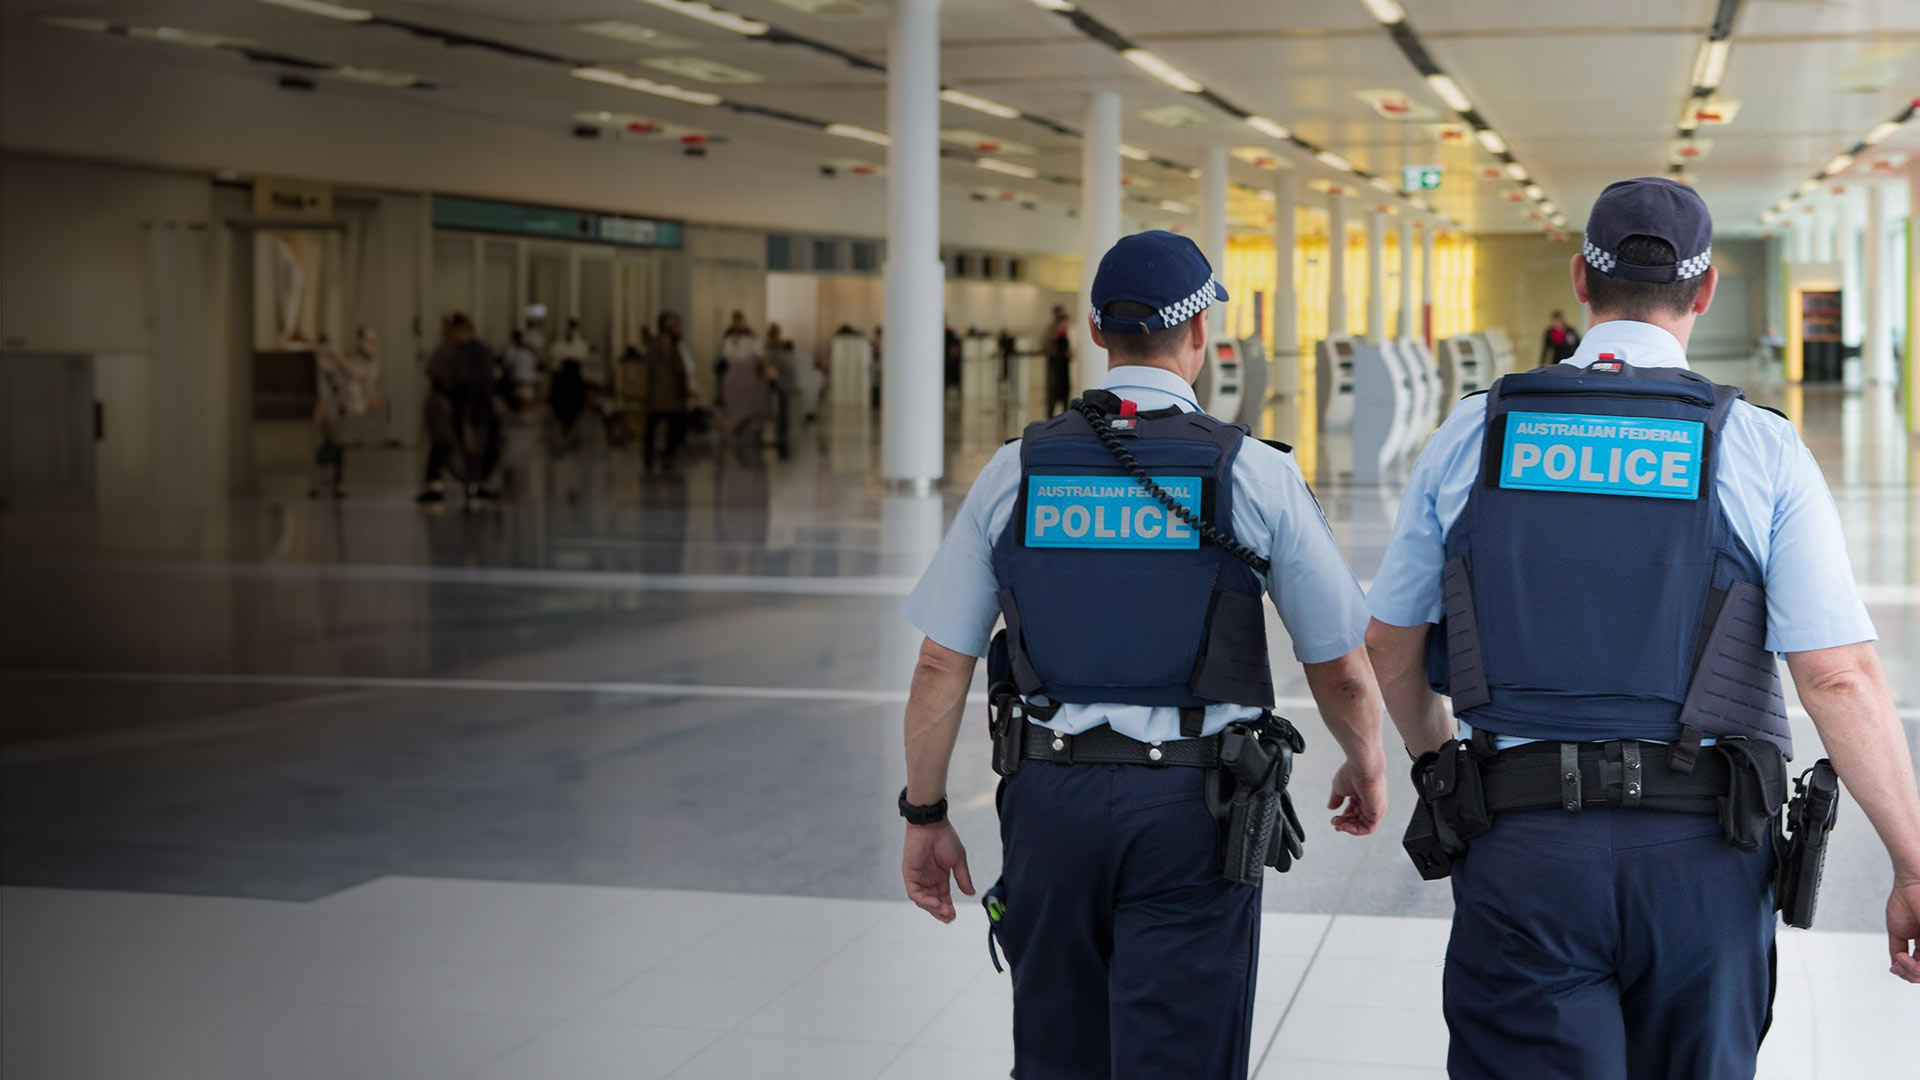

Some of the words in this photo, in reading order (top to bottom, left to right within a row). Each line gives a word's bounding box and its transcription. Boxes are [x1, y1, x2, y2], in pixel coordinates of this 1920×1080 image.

[1516, 422, 1616, 439] AUSTRALIAN
[1619, 427, 1692, 444] FEDERAL
[1511, 443, 1691, 487] POLICE
[1037, 485, 1125, 498] AUSTRALIAN
[1034, 504, 1191, 539] POLICE
